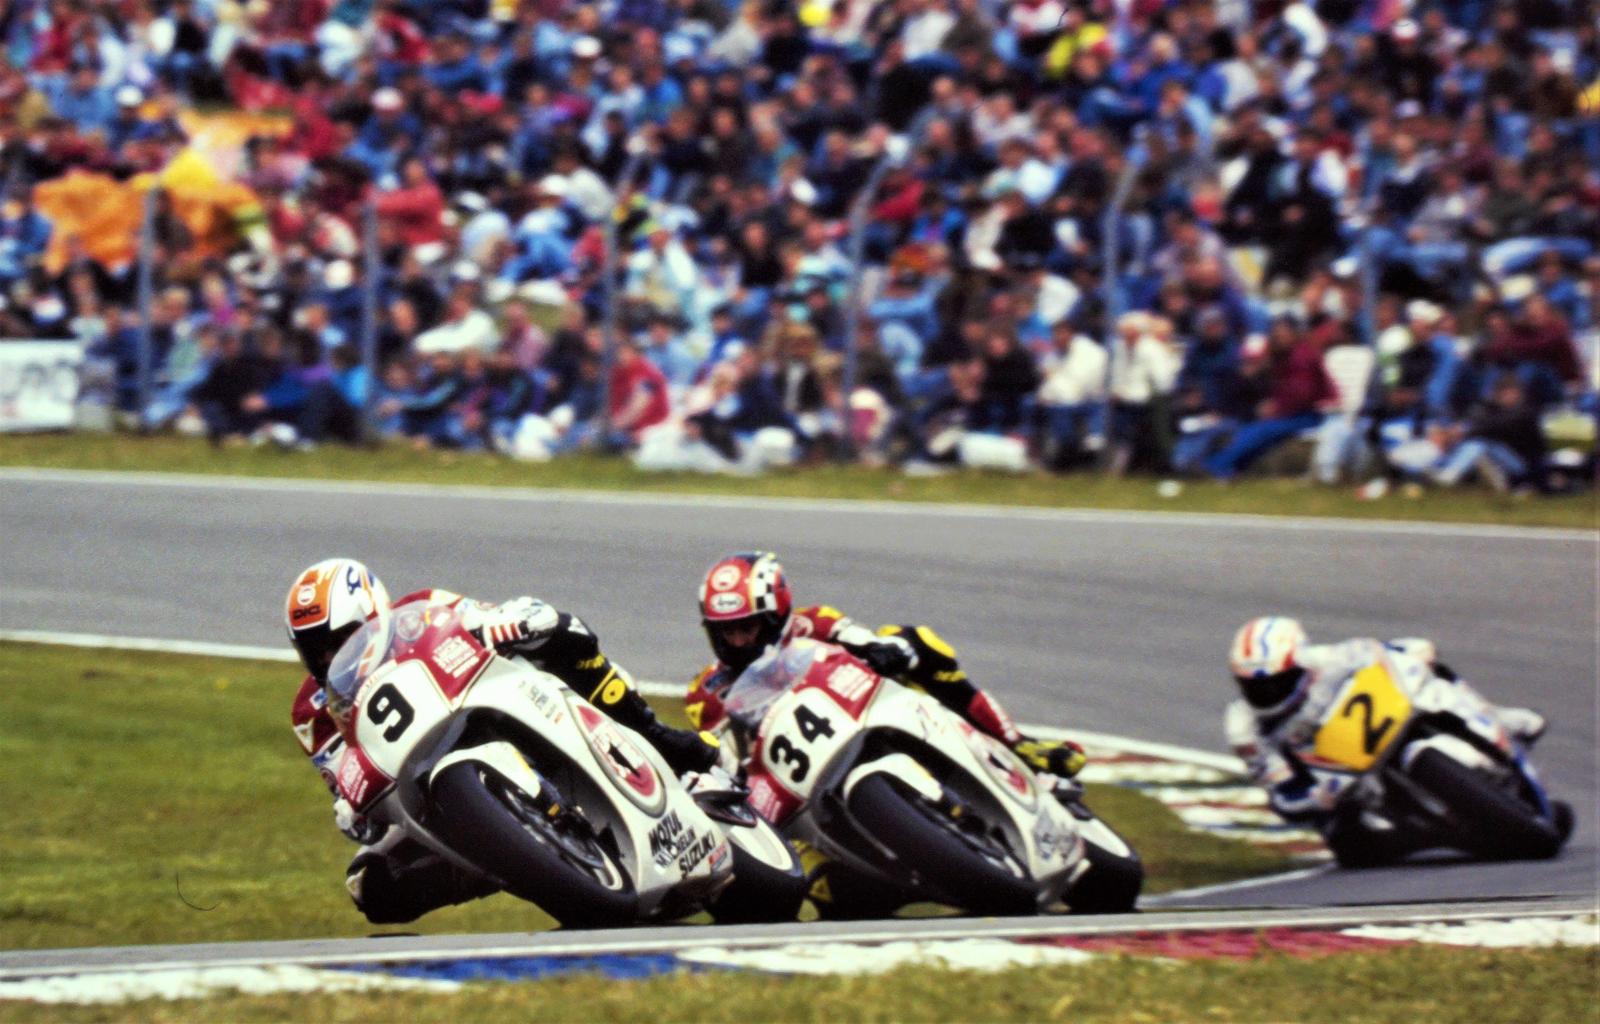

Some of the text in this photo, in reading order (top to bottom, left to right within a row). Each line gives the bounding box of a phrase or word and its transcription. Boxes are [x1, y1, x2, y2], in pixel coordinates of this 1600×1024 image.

[367, 682, 415, 743] 9
[1343, 693, 1394, 755] 2
[769, 704, 835, 783] 34
[648, 809, 682, 857] MOTUL
[679, 830, 716, 875] SUZUKI
